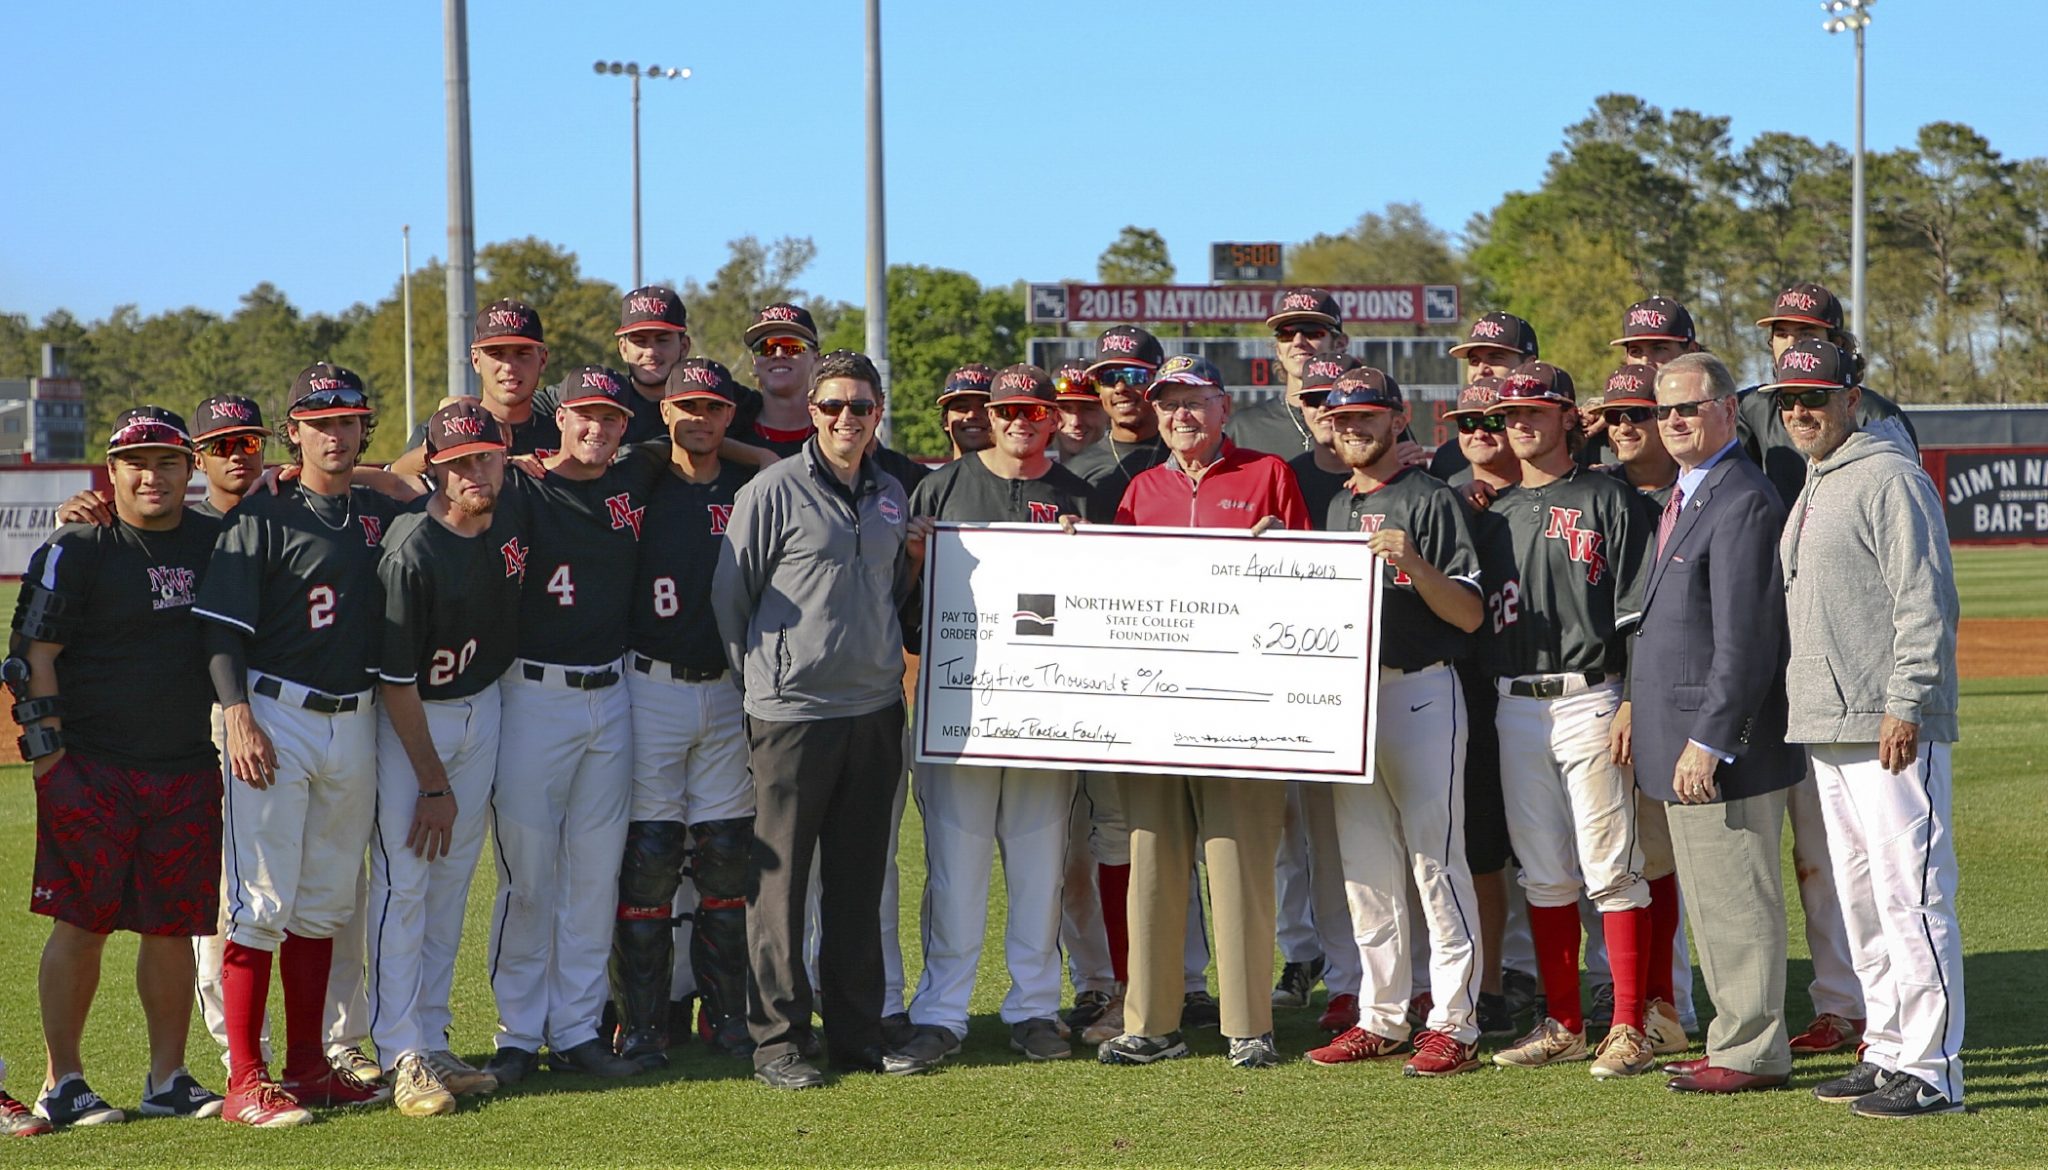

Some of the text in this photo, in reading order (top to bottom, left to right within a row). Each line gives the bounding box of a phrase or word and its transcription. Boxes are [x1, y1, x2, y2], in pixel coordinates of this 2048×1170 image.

[1231, 244, 1278, 267] 5:00
[630, 296, 668, 316] NWF
[1078, 288, 1414, 319] 2015 NATIONAL PIONS
[488, 309, 529, 330] NWF
[1251, 358, 1269, 386] 0
[359, 515, 382, 547] N
[1545, 506, 1607, 586] NWF
[147, 566, 195, 592] NWF
[1211, 565, 1241, 576] DATE
[1246, 553, 1284, 583] April
[1308, 562, 1337, 580] 2018
[547, 564, 575, 606] 4
[652, 576, 680, 618] 8
[308, 584, 336, 630] 2
[941, 611, 999, 624] PAY TO THE
[1065, 595, 1240, 615] NORTHWEST FLORIDA
[1488, 578, 1521, 635] 22
[940, 628, 994, 640] ORDER OF
[1106, 615, 1196, 628] STATE COLLEGE
[1110, 629, 1190, 642] FOUNDATION
[429, 638, 479, 687] 20
[1034, 662, 1116, 692] Thousand
[1287, 692, 1342, 706] DOLLARS
[942, 725, 980, 738] MEMO
